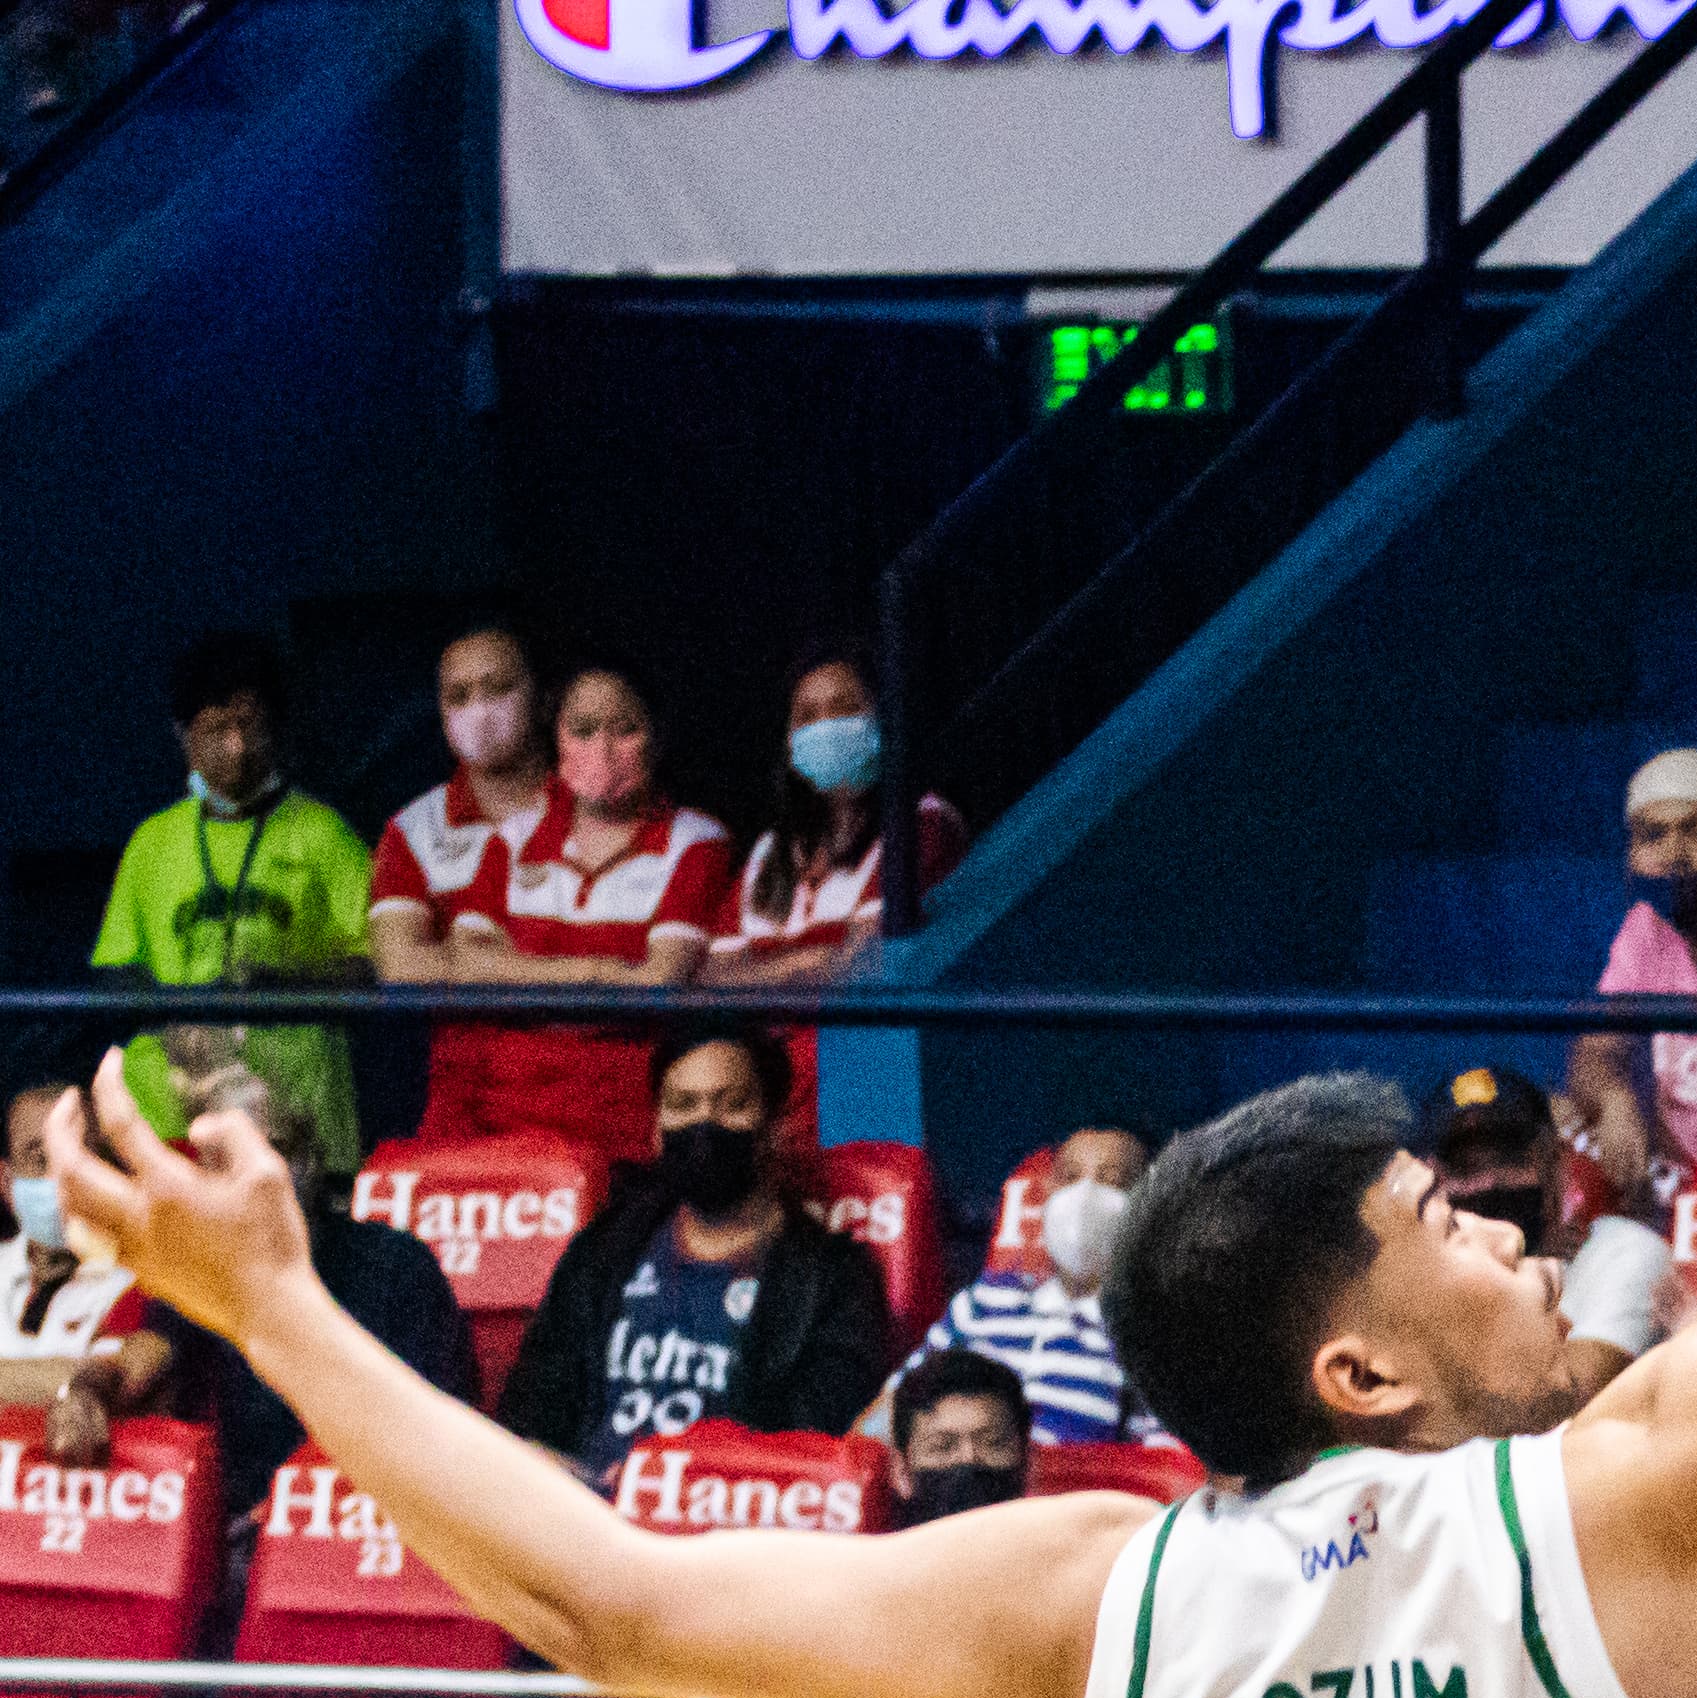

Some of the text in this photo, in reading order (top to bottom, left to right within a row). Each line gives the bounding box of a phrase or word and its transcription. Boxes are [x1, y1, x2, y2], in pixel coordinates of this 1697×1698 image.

[514, 0, 1690, 138] ampn
[352, 1170, 579, 1241] Hanes
[605, 1317, 740, 1393] Letra
[617, 1450, 863, 1530] Hanes
